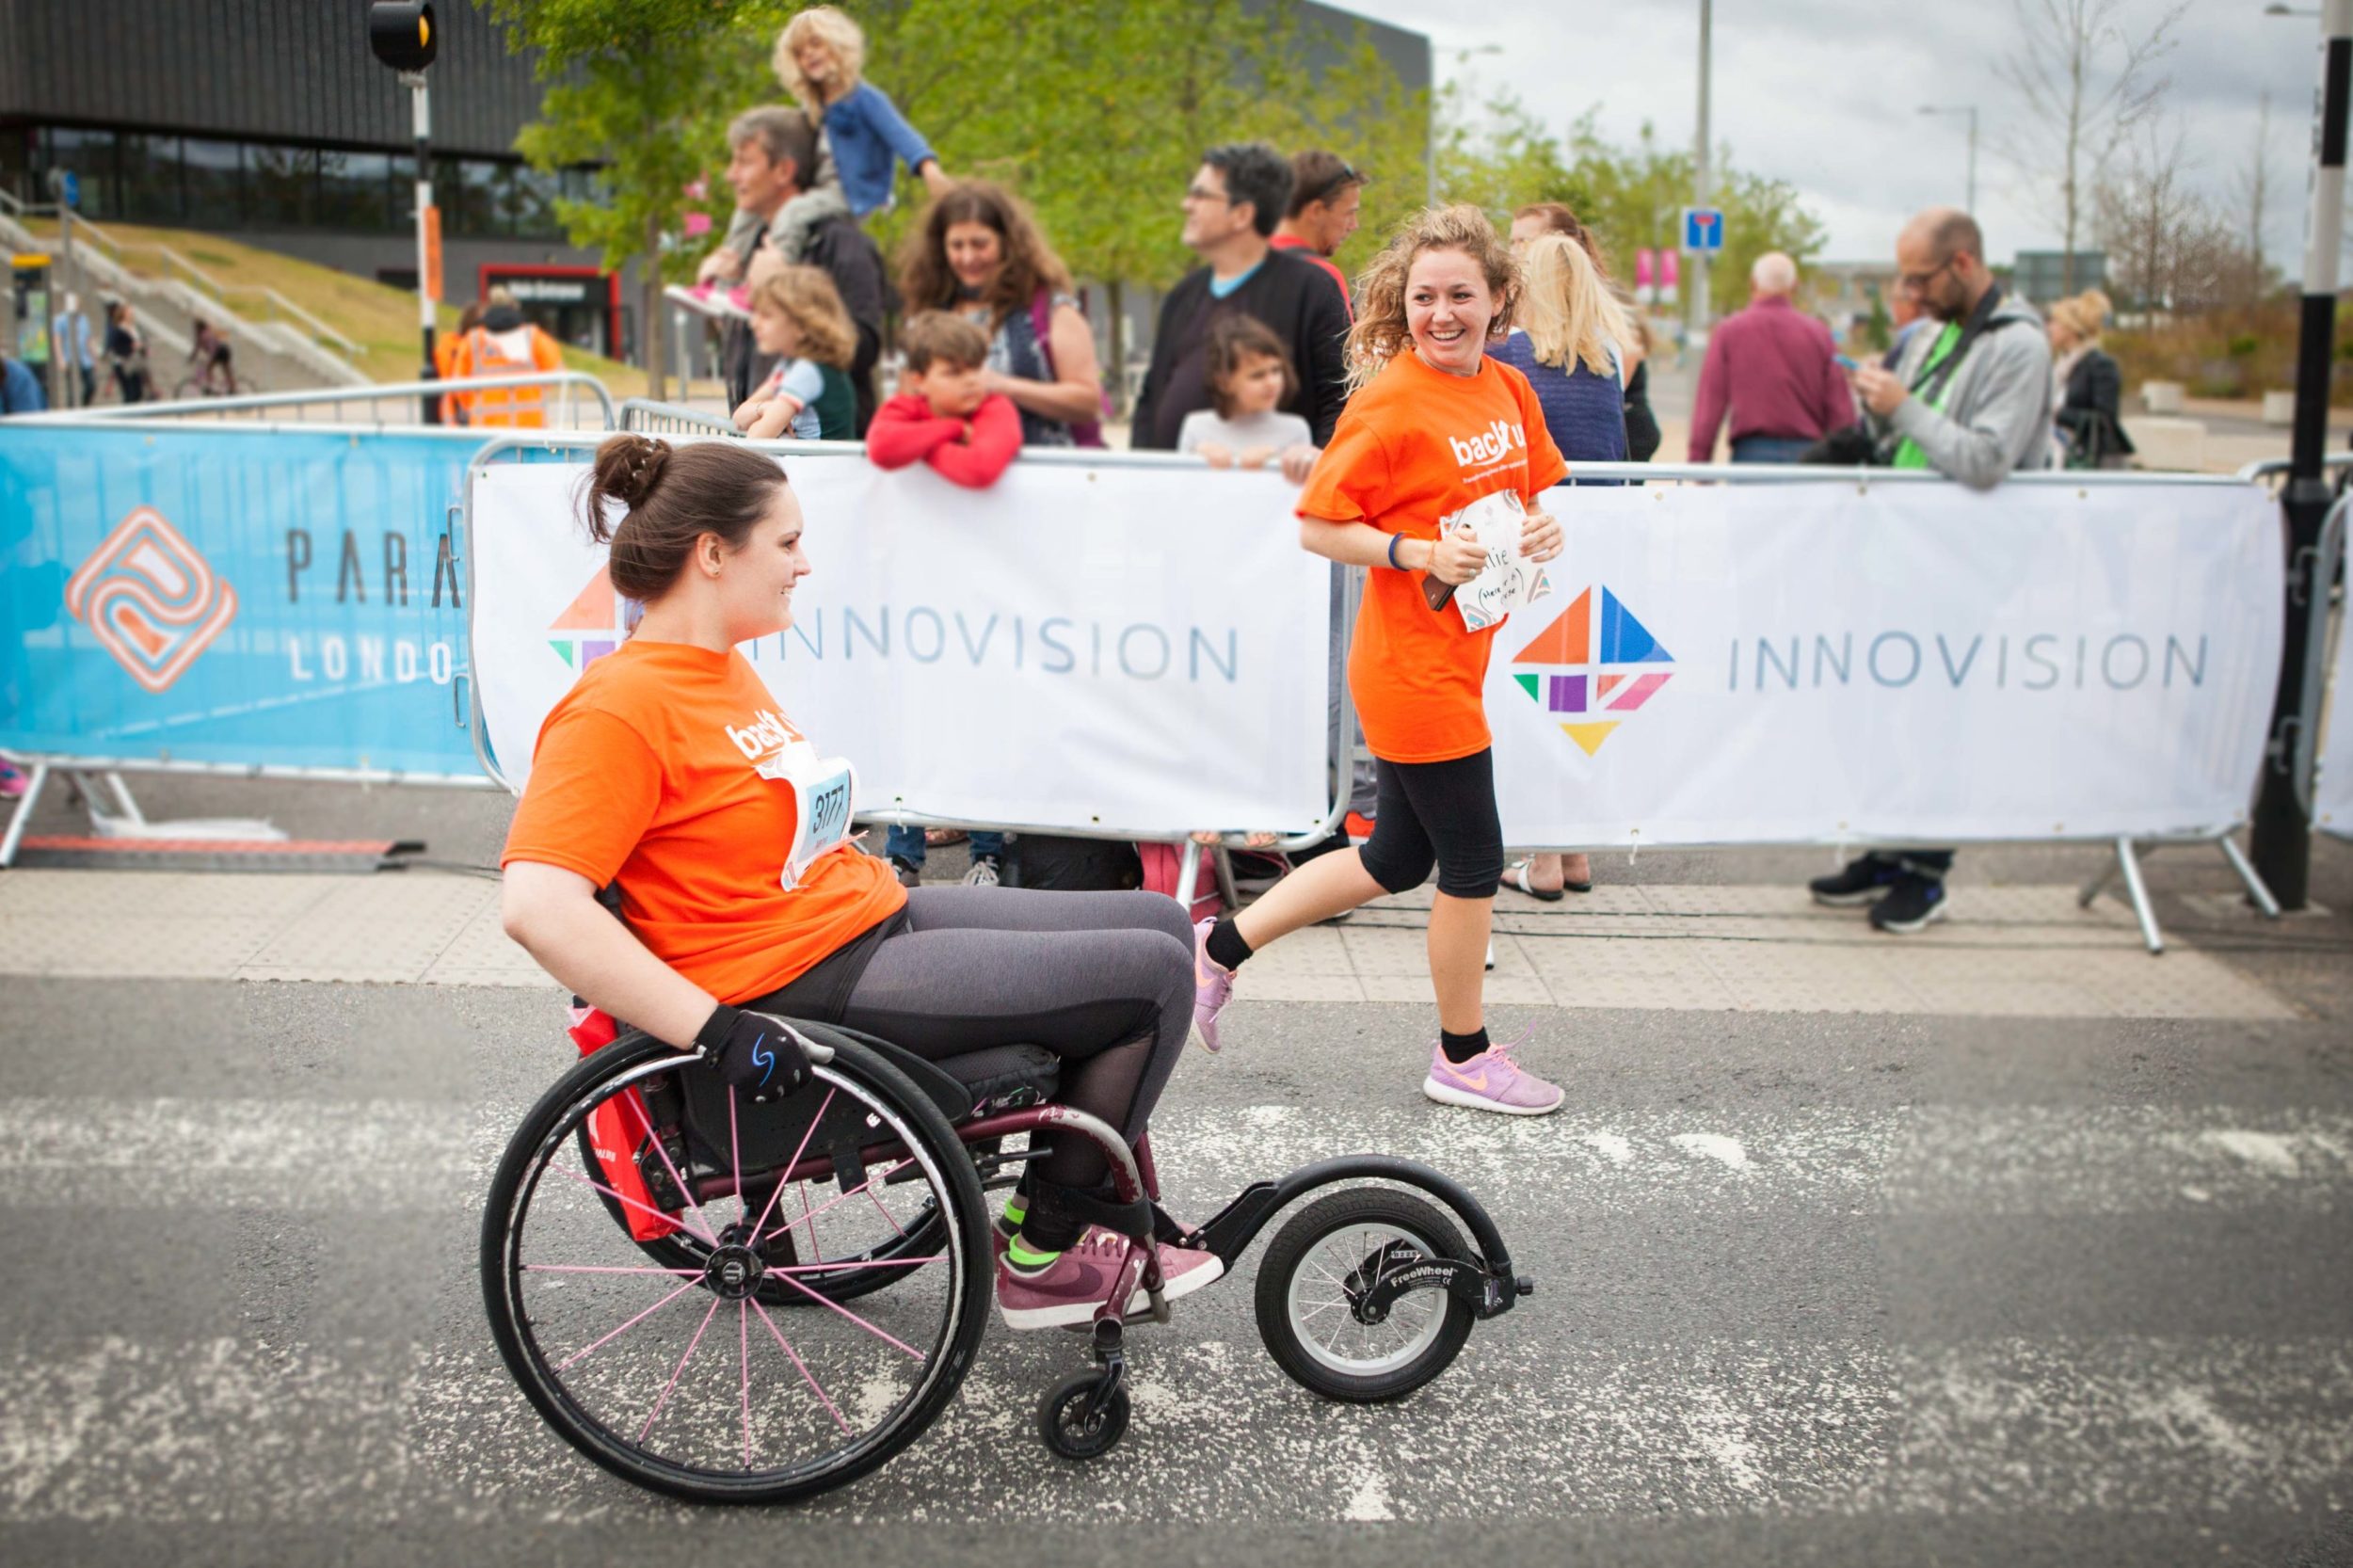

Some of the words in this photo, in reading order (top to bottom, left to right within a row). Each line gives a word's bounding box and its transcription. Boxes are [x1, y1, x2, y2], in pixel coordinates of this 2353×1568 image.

[1449, 419, 1513, 467] back
[287, 529, 461, 608] PARA
[289, 634, 453, 685] LONDO
[1728, 630, 2208, 692] INNOVISION
[813, 784, 844, 835] 3177
